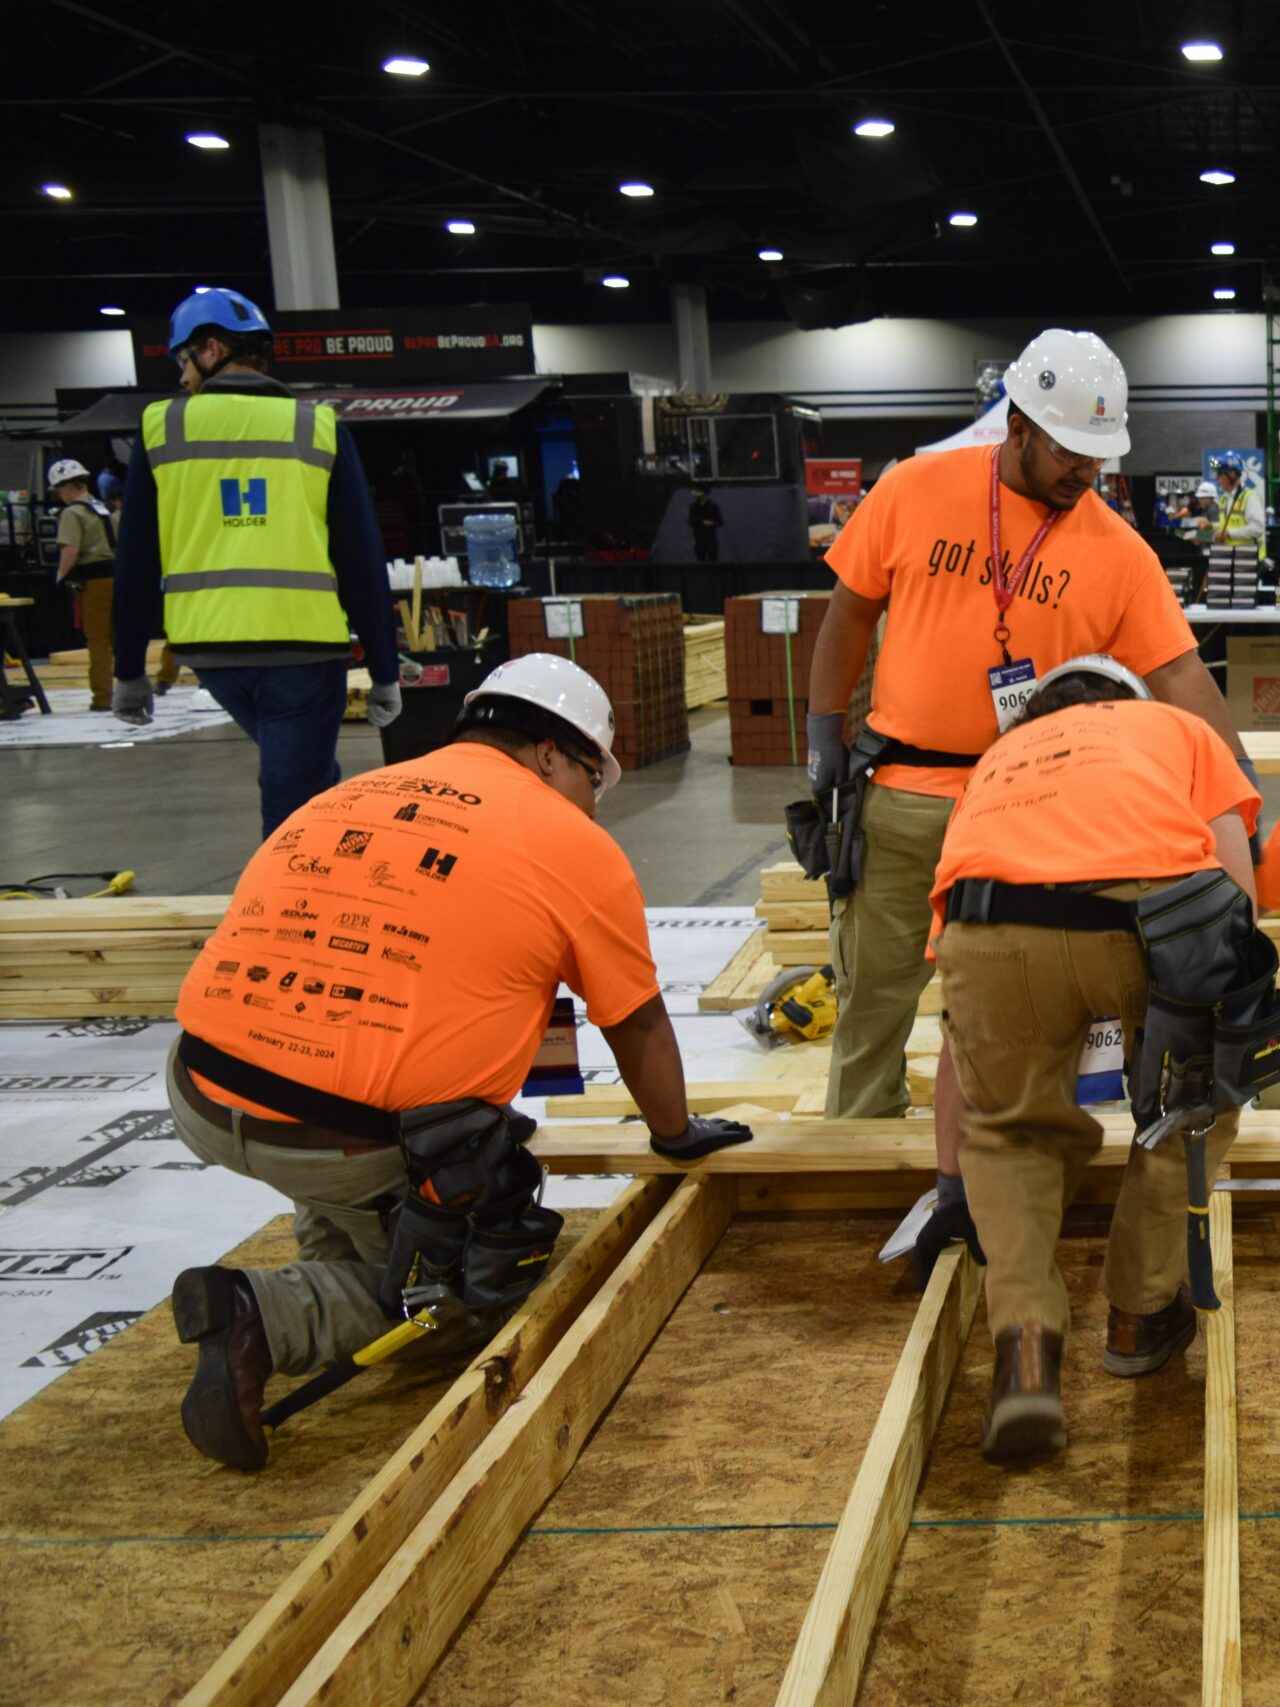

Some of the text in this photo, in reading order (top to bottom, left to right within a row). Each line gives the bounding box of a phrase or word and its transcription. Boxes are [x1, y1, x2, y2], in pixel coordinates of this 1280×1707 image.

[326, 337, 345, 354] BE
[348, 335, 394, 352] PROUD
[345, 395, 459, 412] PROUD
[1158, 479, 1190, 491] KIND
[223, 517, 267, 528] HOLDER
[928, 539, 1072, 610] got sklls?
[396, 780, 482, 806] EXPO
[416, 813, 470, 835] CONSTRUCTION
[415, 867, 447, 883] HOLDER
[379, 995, 409, 1010] Kiewit
[248, 1030, 335, 1059] February 22-23, 2024
[1087, 1029, 1123, 1049] 9062
